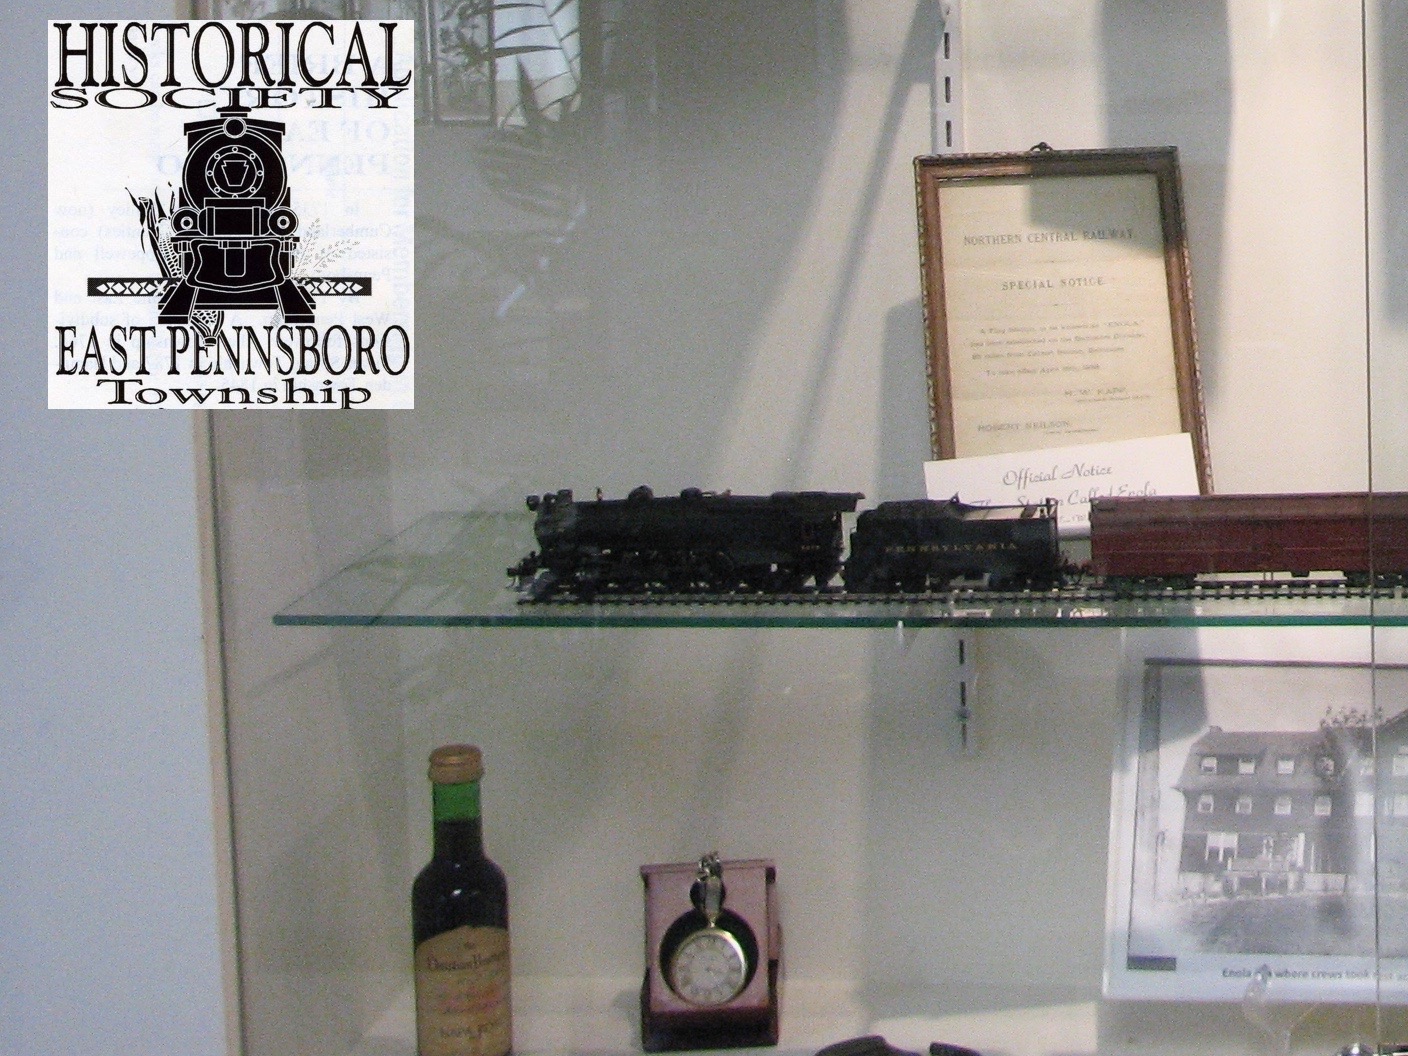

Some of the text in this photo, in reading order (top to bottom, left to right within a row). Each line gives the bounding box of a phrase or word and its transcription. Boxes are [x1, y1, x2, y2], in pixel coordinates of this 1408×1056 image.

[964, 234, 1023, 245] NORTHERN
[1027, 232, 1078, 243] CENTRAL
[1002, 277, 1106, 291] SPECIAL NOTICE
[1002, 463, 1114, 490] Official Notice
[1222, 968, 1252, 977] Enola
[1274, 968, 1310, 978] where
[1311, 970, 1342, 978] crews
